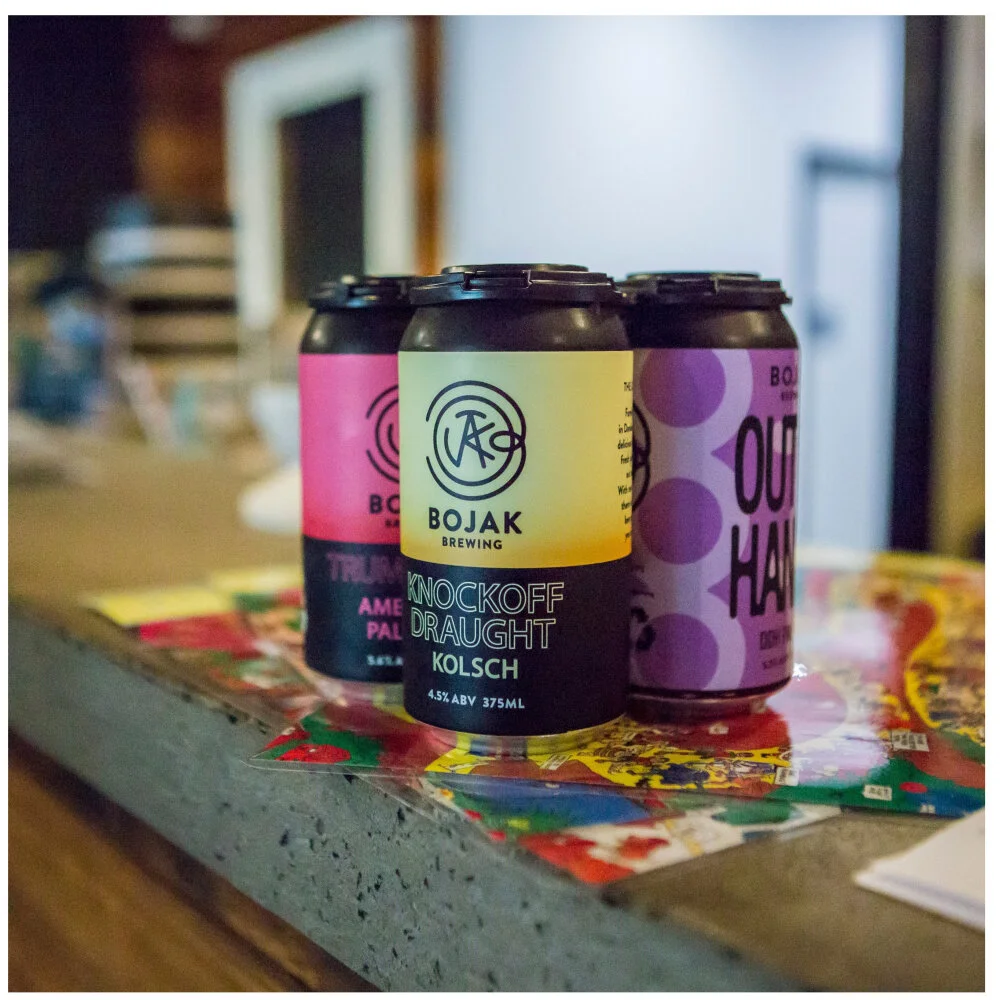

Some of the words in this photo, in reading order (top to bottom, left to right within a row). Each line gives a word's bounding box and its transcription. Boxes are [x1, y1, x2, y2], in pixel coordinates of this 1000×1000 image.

[428, 507, 522, 534] BOJAK
[442, 536, 503, 550] BREWING
[407, 571, 565, 615] KNOCKOFF
[410, 607, 556, 650] DRAUGHT
[432, 651, 519, 680] KOLSCH
[427, 688, 450, 703] 4.5%
[451, 694, 477, 707] ABV
[482, 696, 526, 710] 375ML
